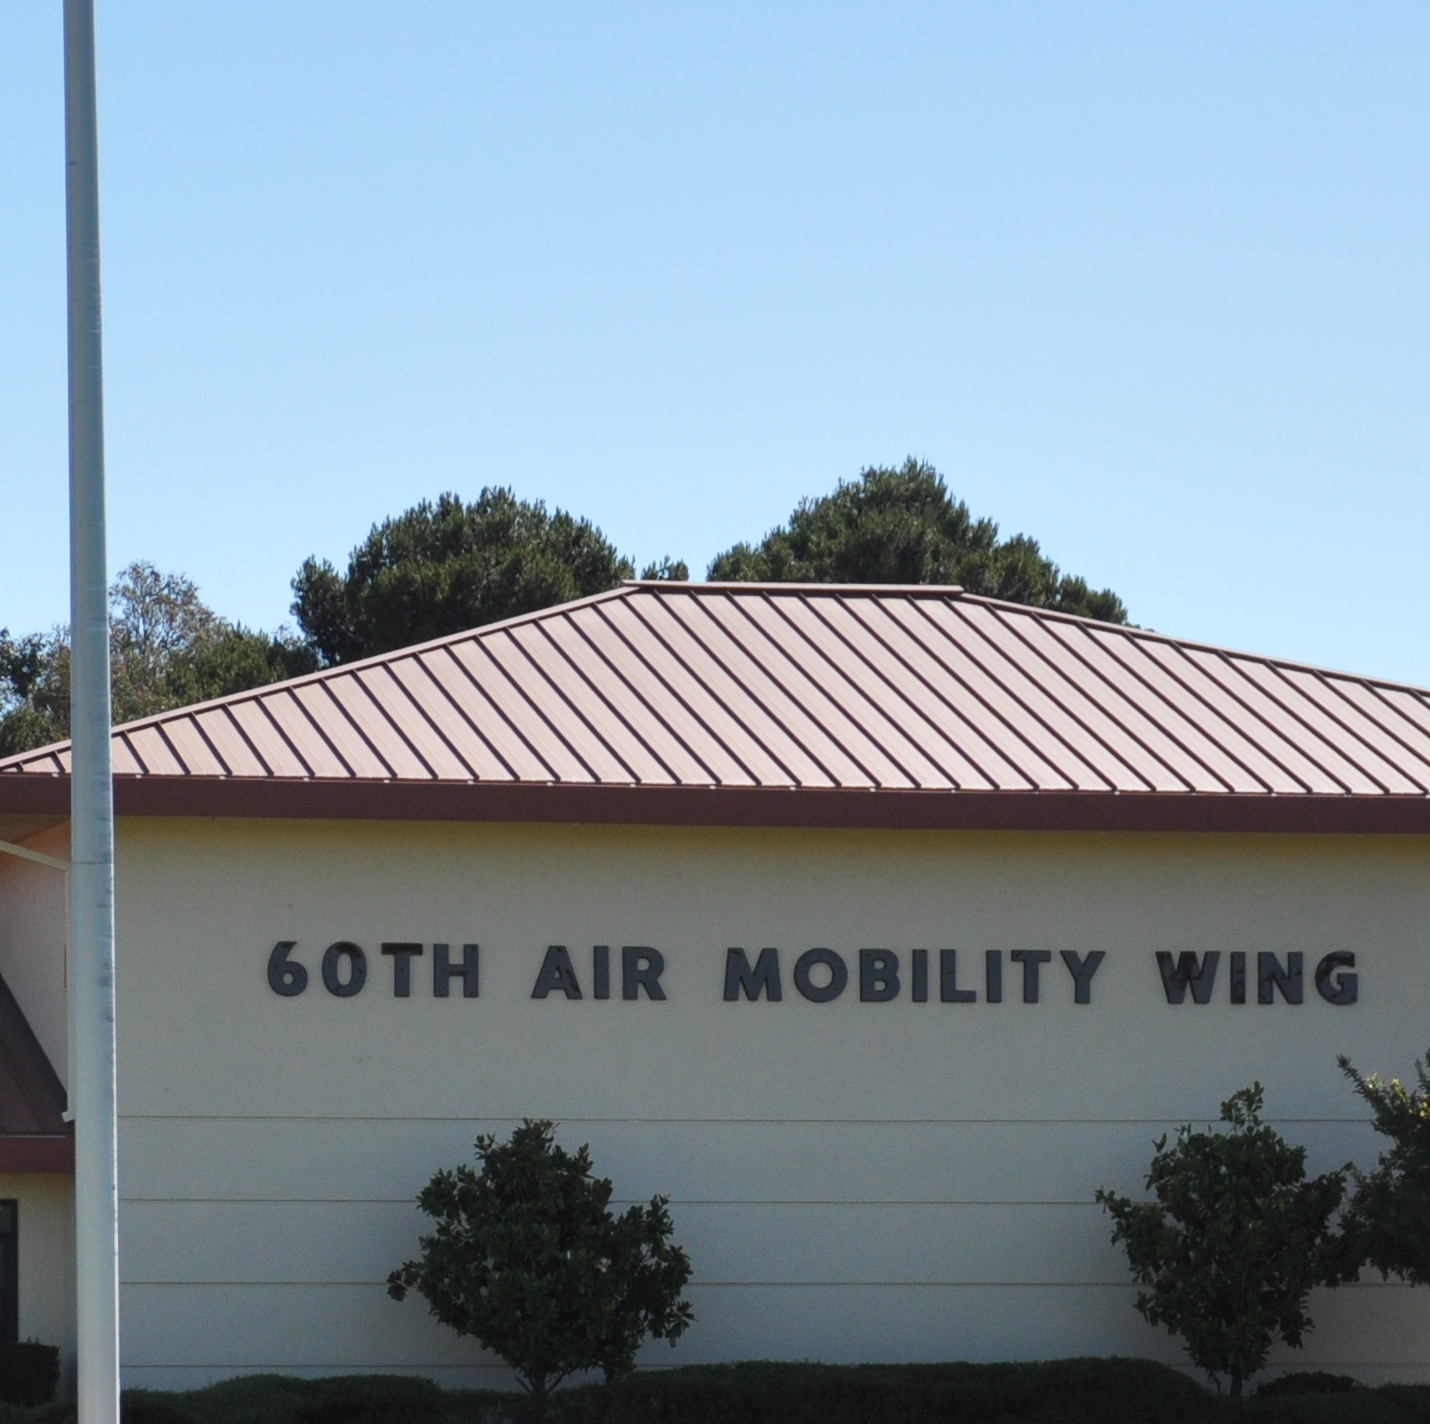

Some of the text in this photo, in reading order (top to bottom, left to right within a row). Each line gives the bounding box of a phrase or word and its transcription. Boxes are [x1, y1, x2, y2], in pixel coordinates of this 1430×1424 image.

[266, 940, 1360, 1007] 60TH AIR MOBILITY WING
